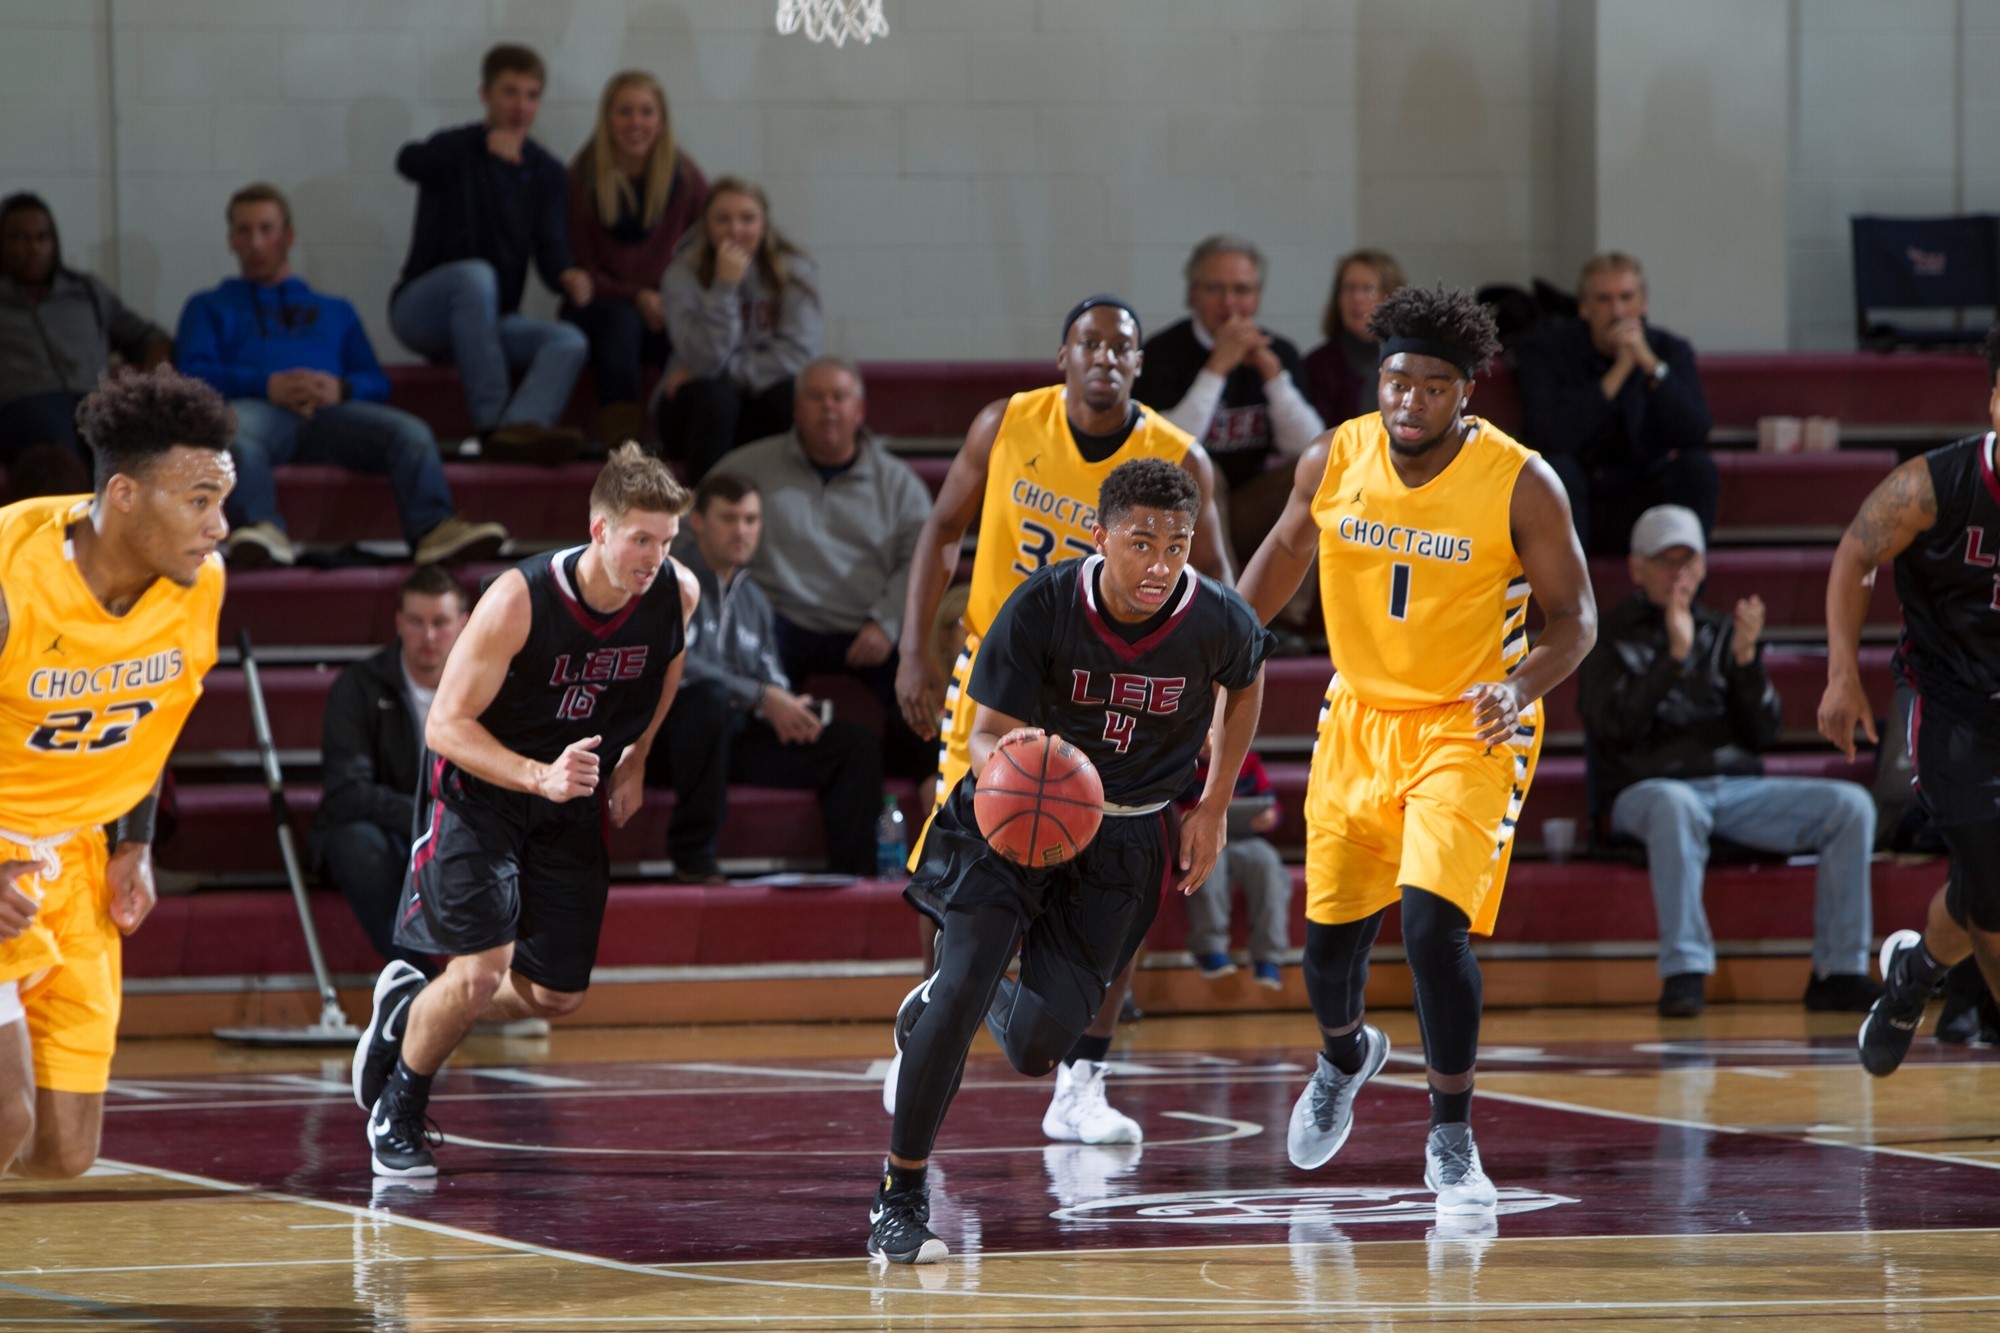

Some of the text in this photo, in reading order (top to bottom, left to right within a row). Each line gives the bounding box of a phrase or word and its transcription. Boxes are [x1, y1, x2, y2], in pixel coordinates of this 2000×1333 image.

[1012, 478, 1098, 531] CHOCTa
[1389, 563, 1411, 622] 1
[549, 645, 649, 686] LEE
[1071, 669, 1186, 715] LEE
[25, 699, 157, 754] 22
[1102, 710, 1136, 753] 4
